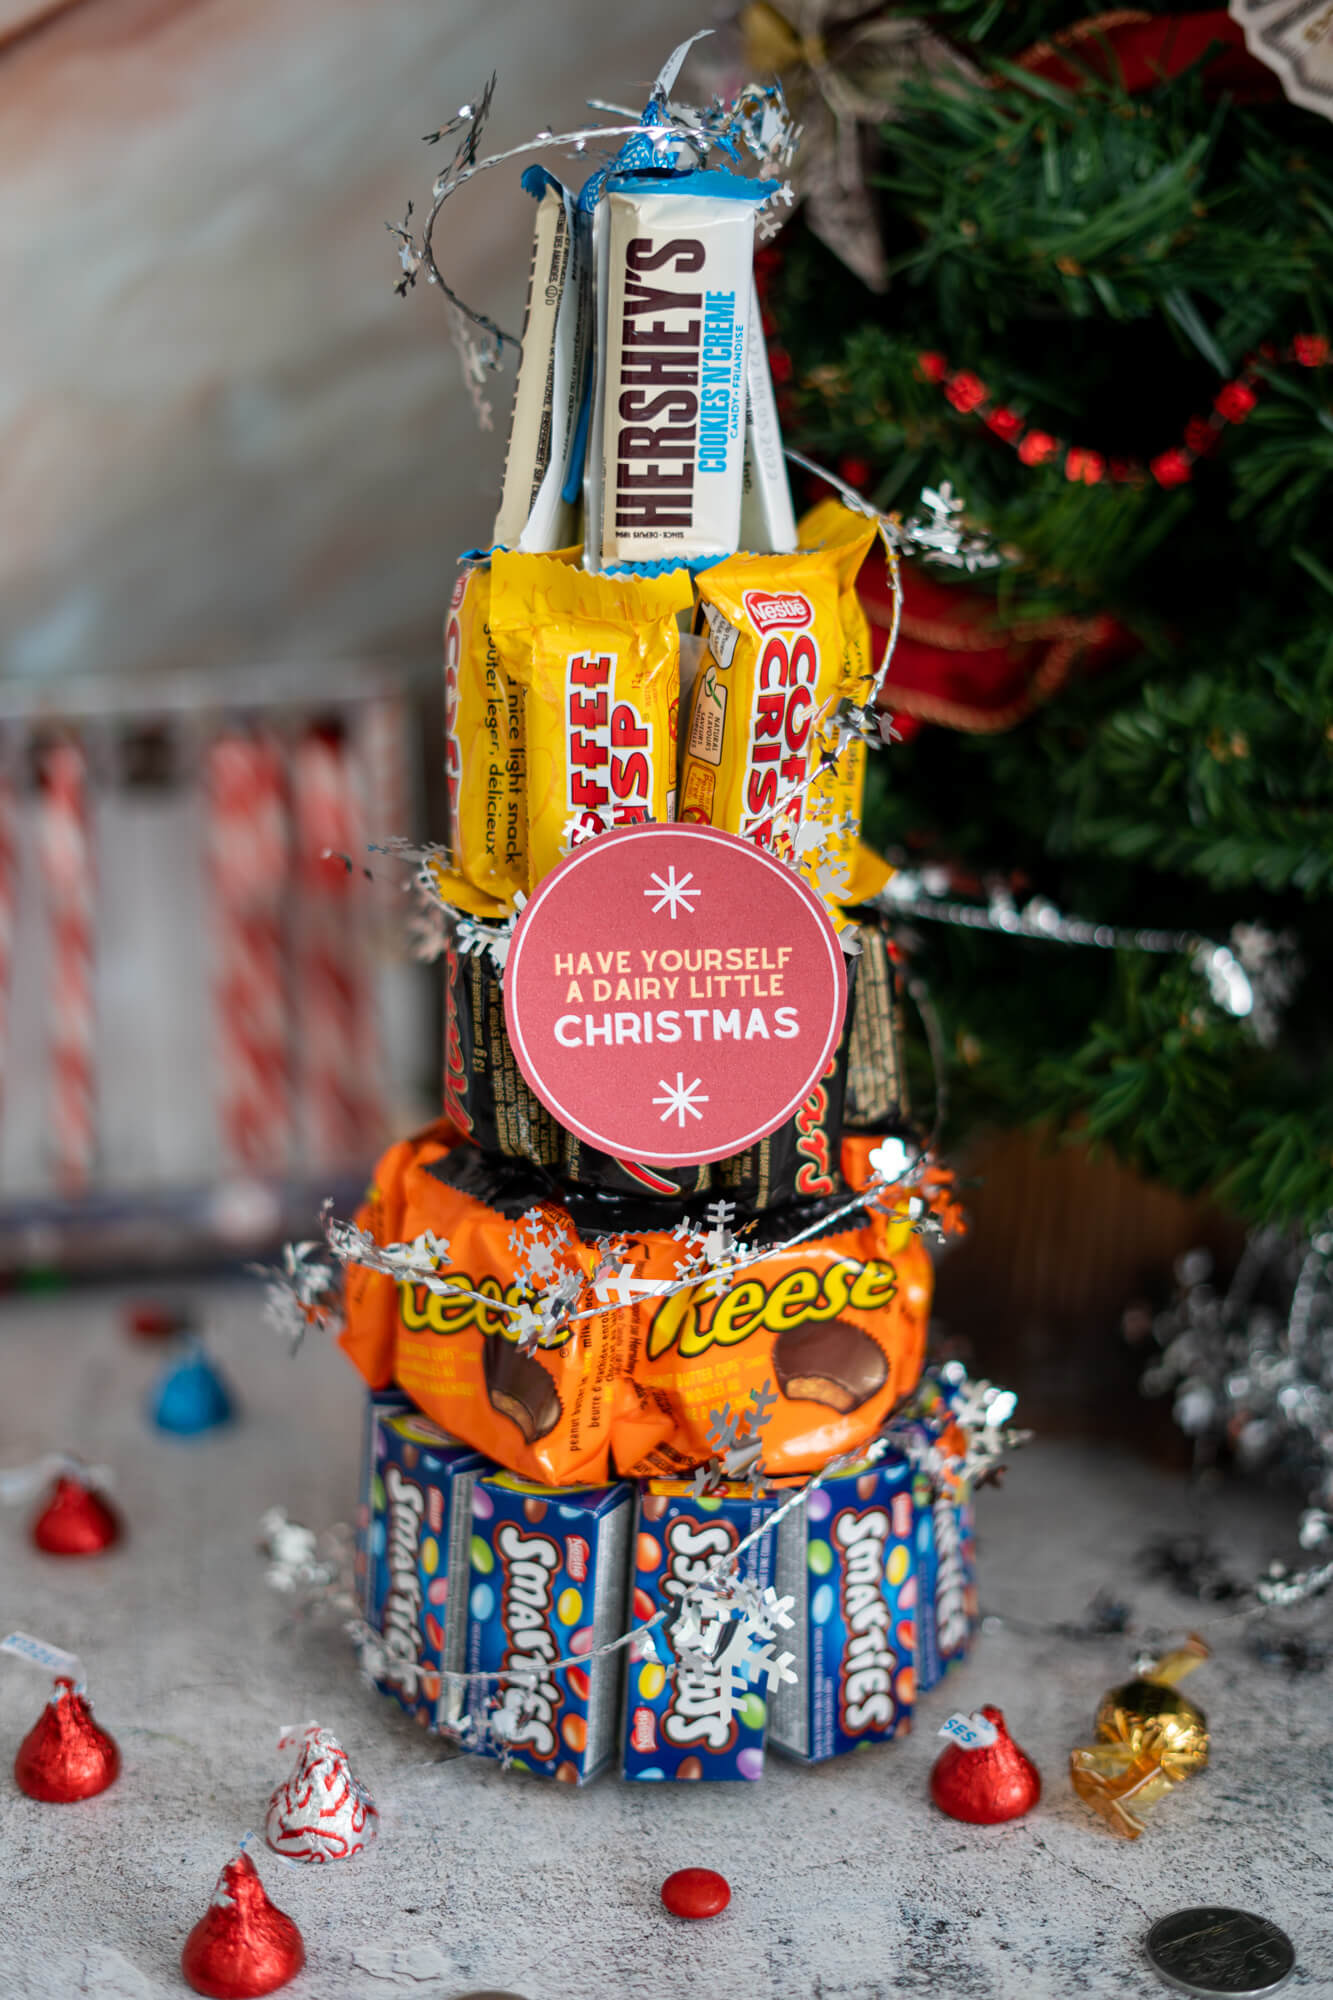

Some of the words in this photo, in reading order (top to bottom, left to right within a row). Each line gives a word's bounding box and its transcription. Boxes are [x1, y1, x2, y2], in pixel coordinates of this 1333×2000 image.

[732, 324, 744, 389] FRIANDISE
[615, 238, 706, 527] HERSHEY'S
[730, 398, 740, 439] CANDY
[633, 531, 659, 539] DEPUIS
[663, 531, 684, 539] SINCE
[507, 690, 524, 739] nice
[505, 745, 526, 793] light
[485, 763, 504, 855] délicieux
[505, 802, 526, 864] snack
[554, 951, 632, 976] HAVE
[641, 947, 793, 973] YOURSELF
[565, 980, 584, 1003] A
[593, 976, 680, 1002] DAIRY
[690, 974, 784, 998] LITTLE
[553, 1006, 800, 1048] CHRISTMAS
[473, 1058, 487, 1073] 13
